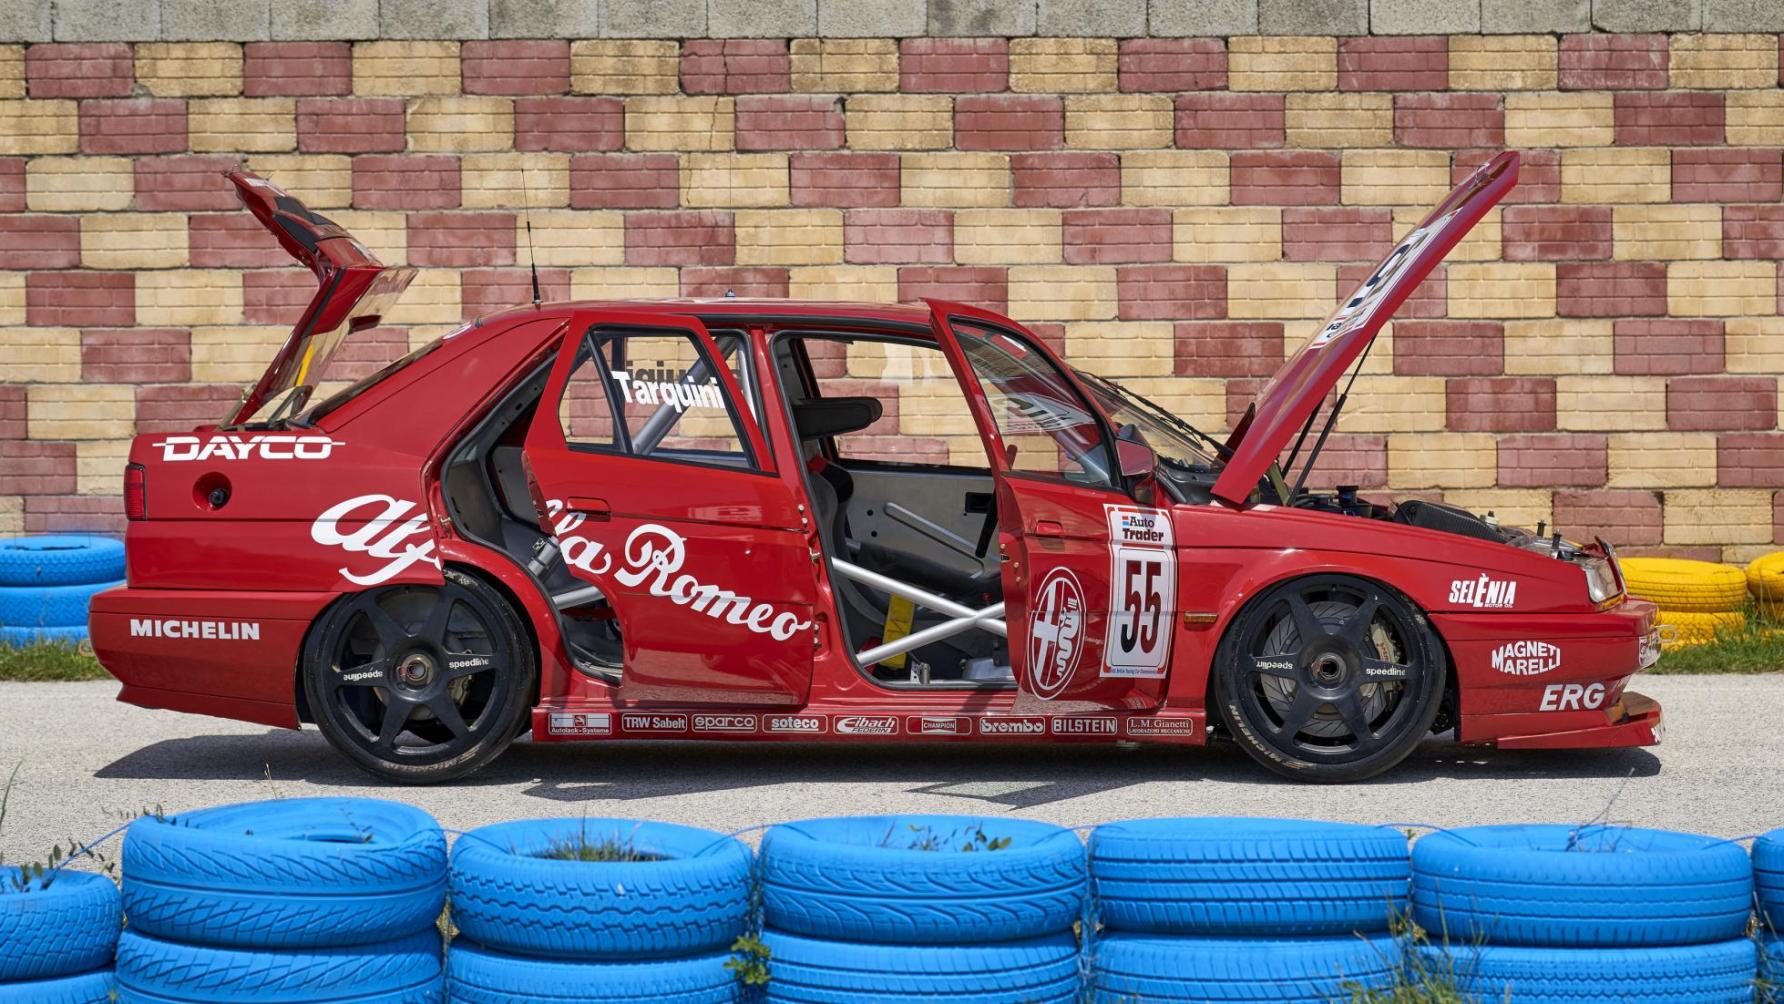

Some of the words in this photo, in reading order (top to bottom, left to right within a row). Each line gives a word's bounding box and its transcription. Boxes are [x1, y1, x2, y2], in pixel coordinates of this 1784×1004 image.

[611, 371, 726, 414] Tarquini
[162, 435, 334, 462] DAYCO
[1129, 516, 1155, 528] Auto
[1122, 528, 1164, 542] Trader
[614, 523, 812, 642] Romeo
[1120, 559, 1162, 654] 55
[130, 619, 261, 641] MICHELIN
[1492, 641, 1561, 663] MAGNETI
[1492, 656, 1561, 676] MARELLI
[342, 669, 384, 682] speedline
[1539, 683, 1606, 712] ERG
[624, 717, 650, 729] TRW
[652, 717, 686, 729] Sabelt
[695, 716, 755, 731] sparco
[771, 717, 820, 729] soteco
[836, 716, 896, 733] Eibach
[981, 719, 1044, 733] brembo
[1053, 719, 1117, 732] BILSTEIN
[1153, 719, 1189, 728] Gianetti
